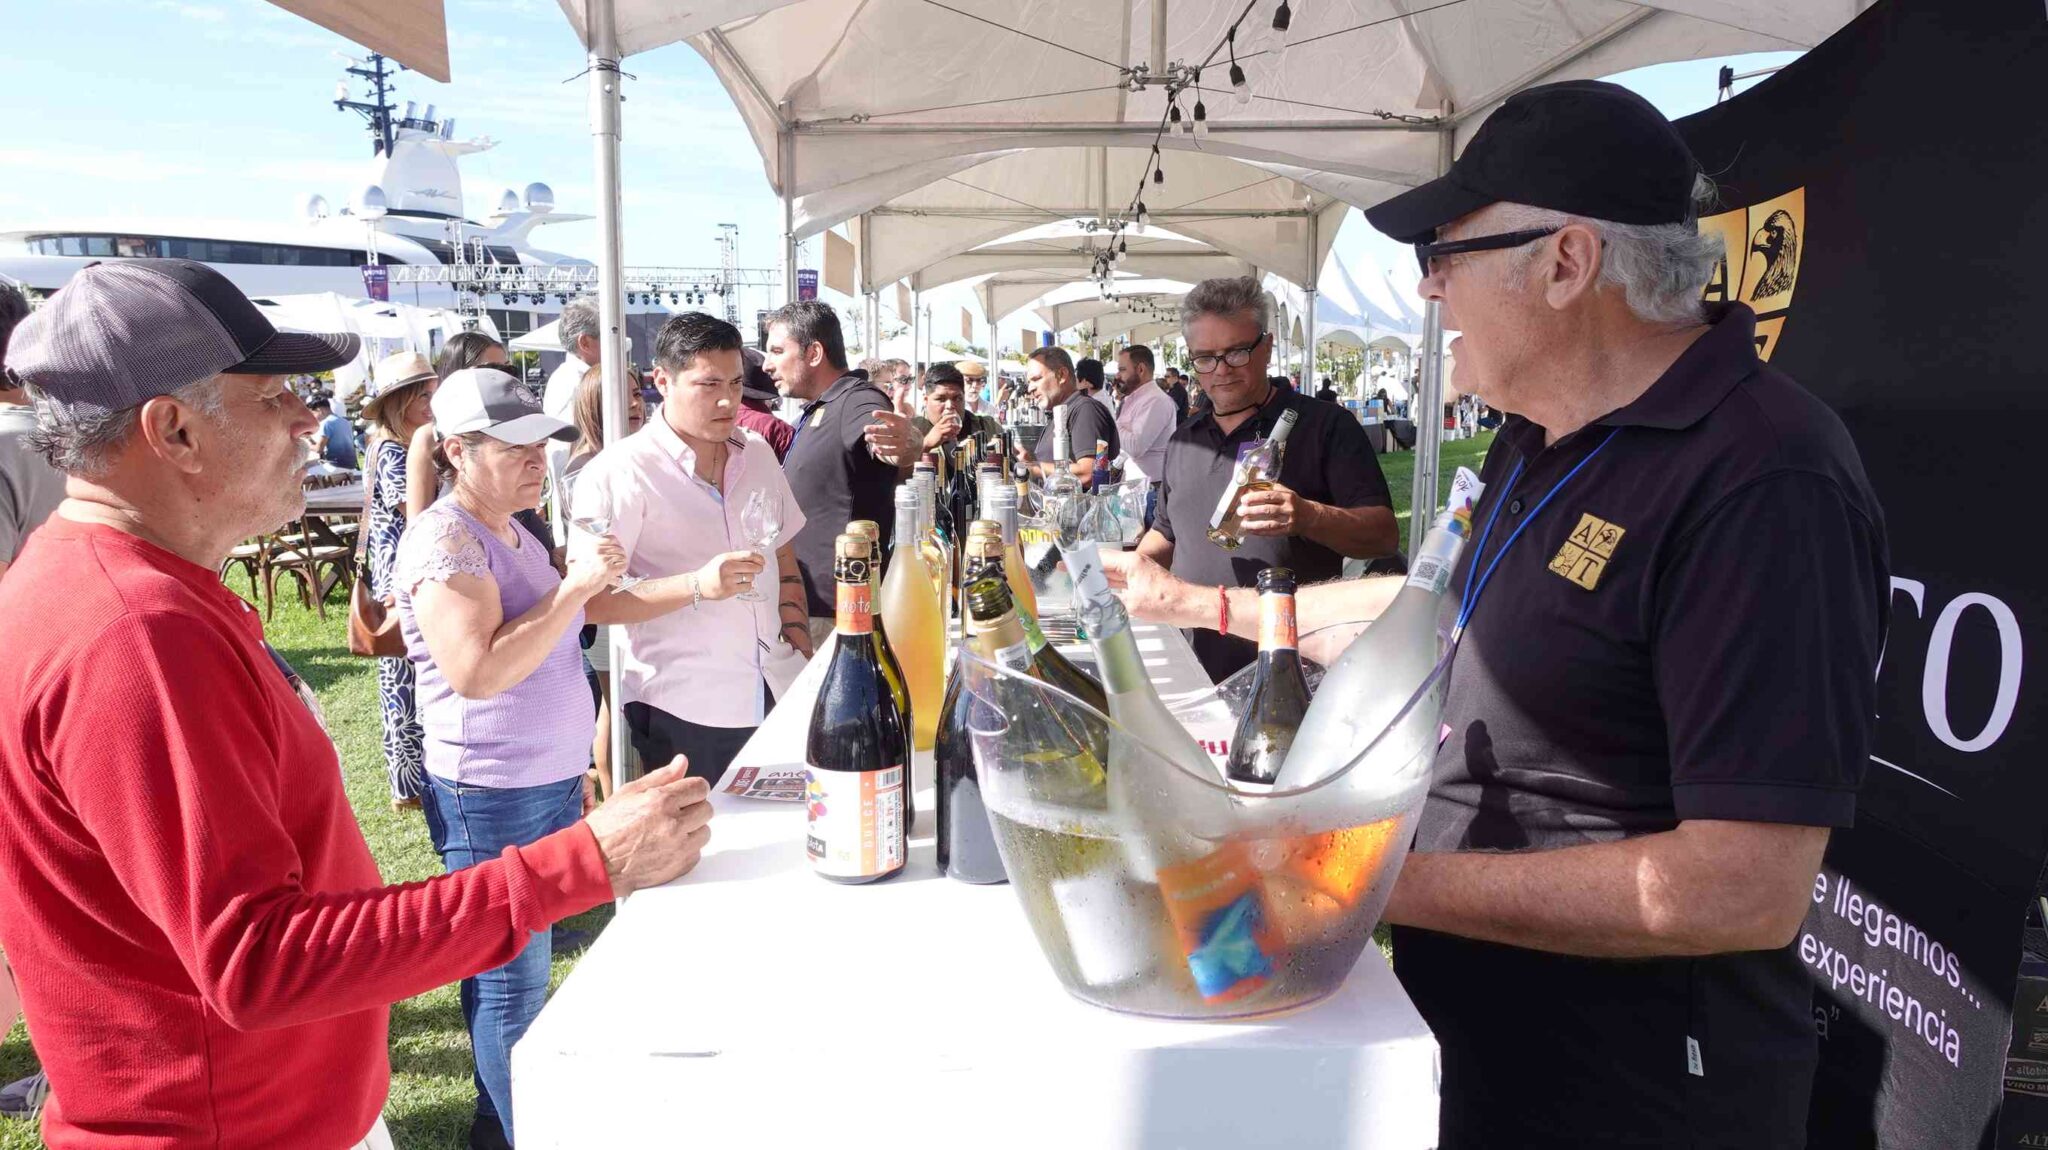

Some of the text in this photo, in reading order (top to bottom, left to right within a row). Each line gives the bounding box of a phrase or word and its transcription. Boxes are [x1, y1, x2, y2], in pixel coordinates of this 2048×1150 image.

[1574, 521, 1593, 545] A
[1577, 556, 1599, 582] T
[863, 799, 874, 849] DULCE
[1833, 874, 1981, 1010] llegamos...
[1800, 932, 1960, 1068] experiencia
[2006, 1080, 2035, 1091] VINO
